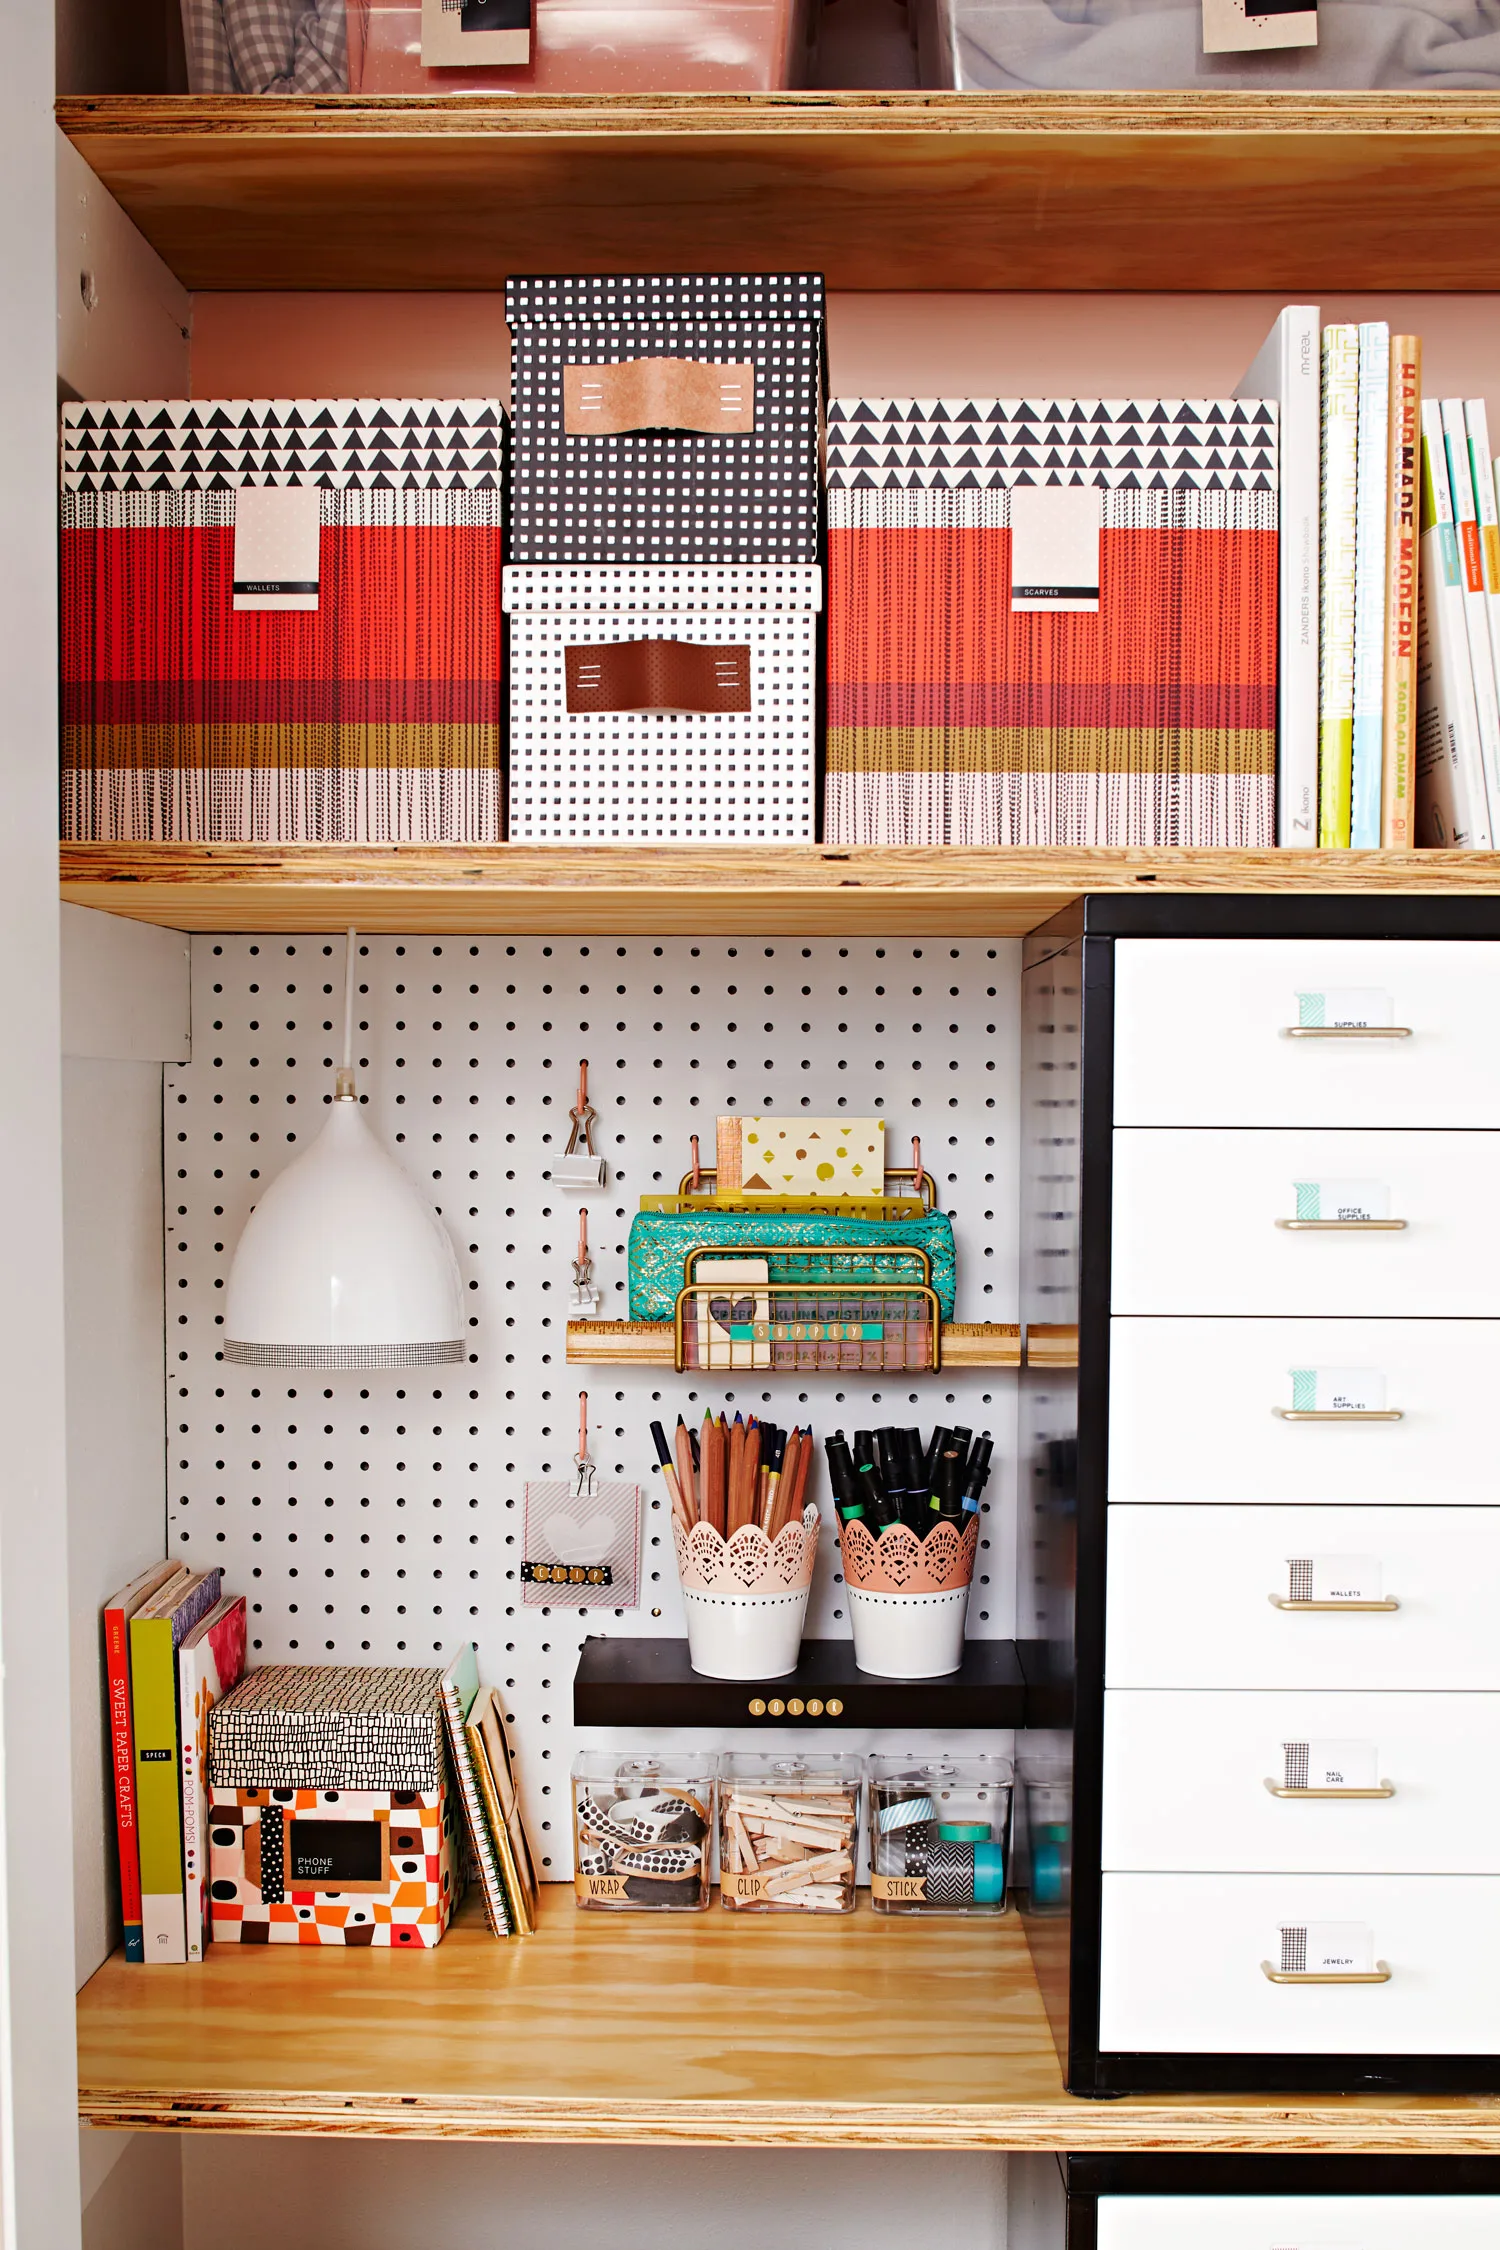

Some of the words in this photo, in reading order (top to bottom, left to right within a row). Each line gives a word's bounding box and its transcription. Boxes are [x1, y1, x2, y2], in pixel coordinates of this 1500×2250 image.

[1393, 363, 1416, 527] HANDMADE
[1466, 526, 1477, 564] Traditional
[1024, 588, 1059, 596] SCARVES
[1301, 566, 1310, 594] ikono
[1391, 539, 1413, 657] MODERN
[1301, 596, 1310, 645] ZANDERS
[1301, 787, 1310, 813] ikono
[757, 1325, 857, 1338] SUPPLY
[539, 1568, 598, 1581] CLIP
[112, 1626, 121, 1654] GREENE
[113, 1679, 127, 1727] SWEET
[116, 1731, 129, 1772] PAPER
[118, 1776, 133, 1828] CRAFTS
[297, 1857, 333, 1866] PHONE
[297, 1866, 330, 1875] STUFF
[588, 1878, 620, 1896] WRAP
[737, 1878, 761, 1897] CLIP
[886, 1880, 918, 1897] STICK
